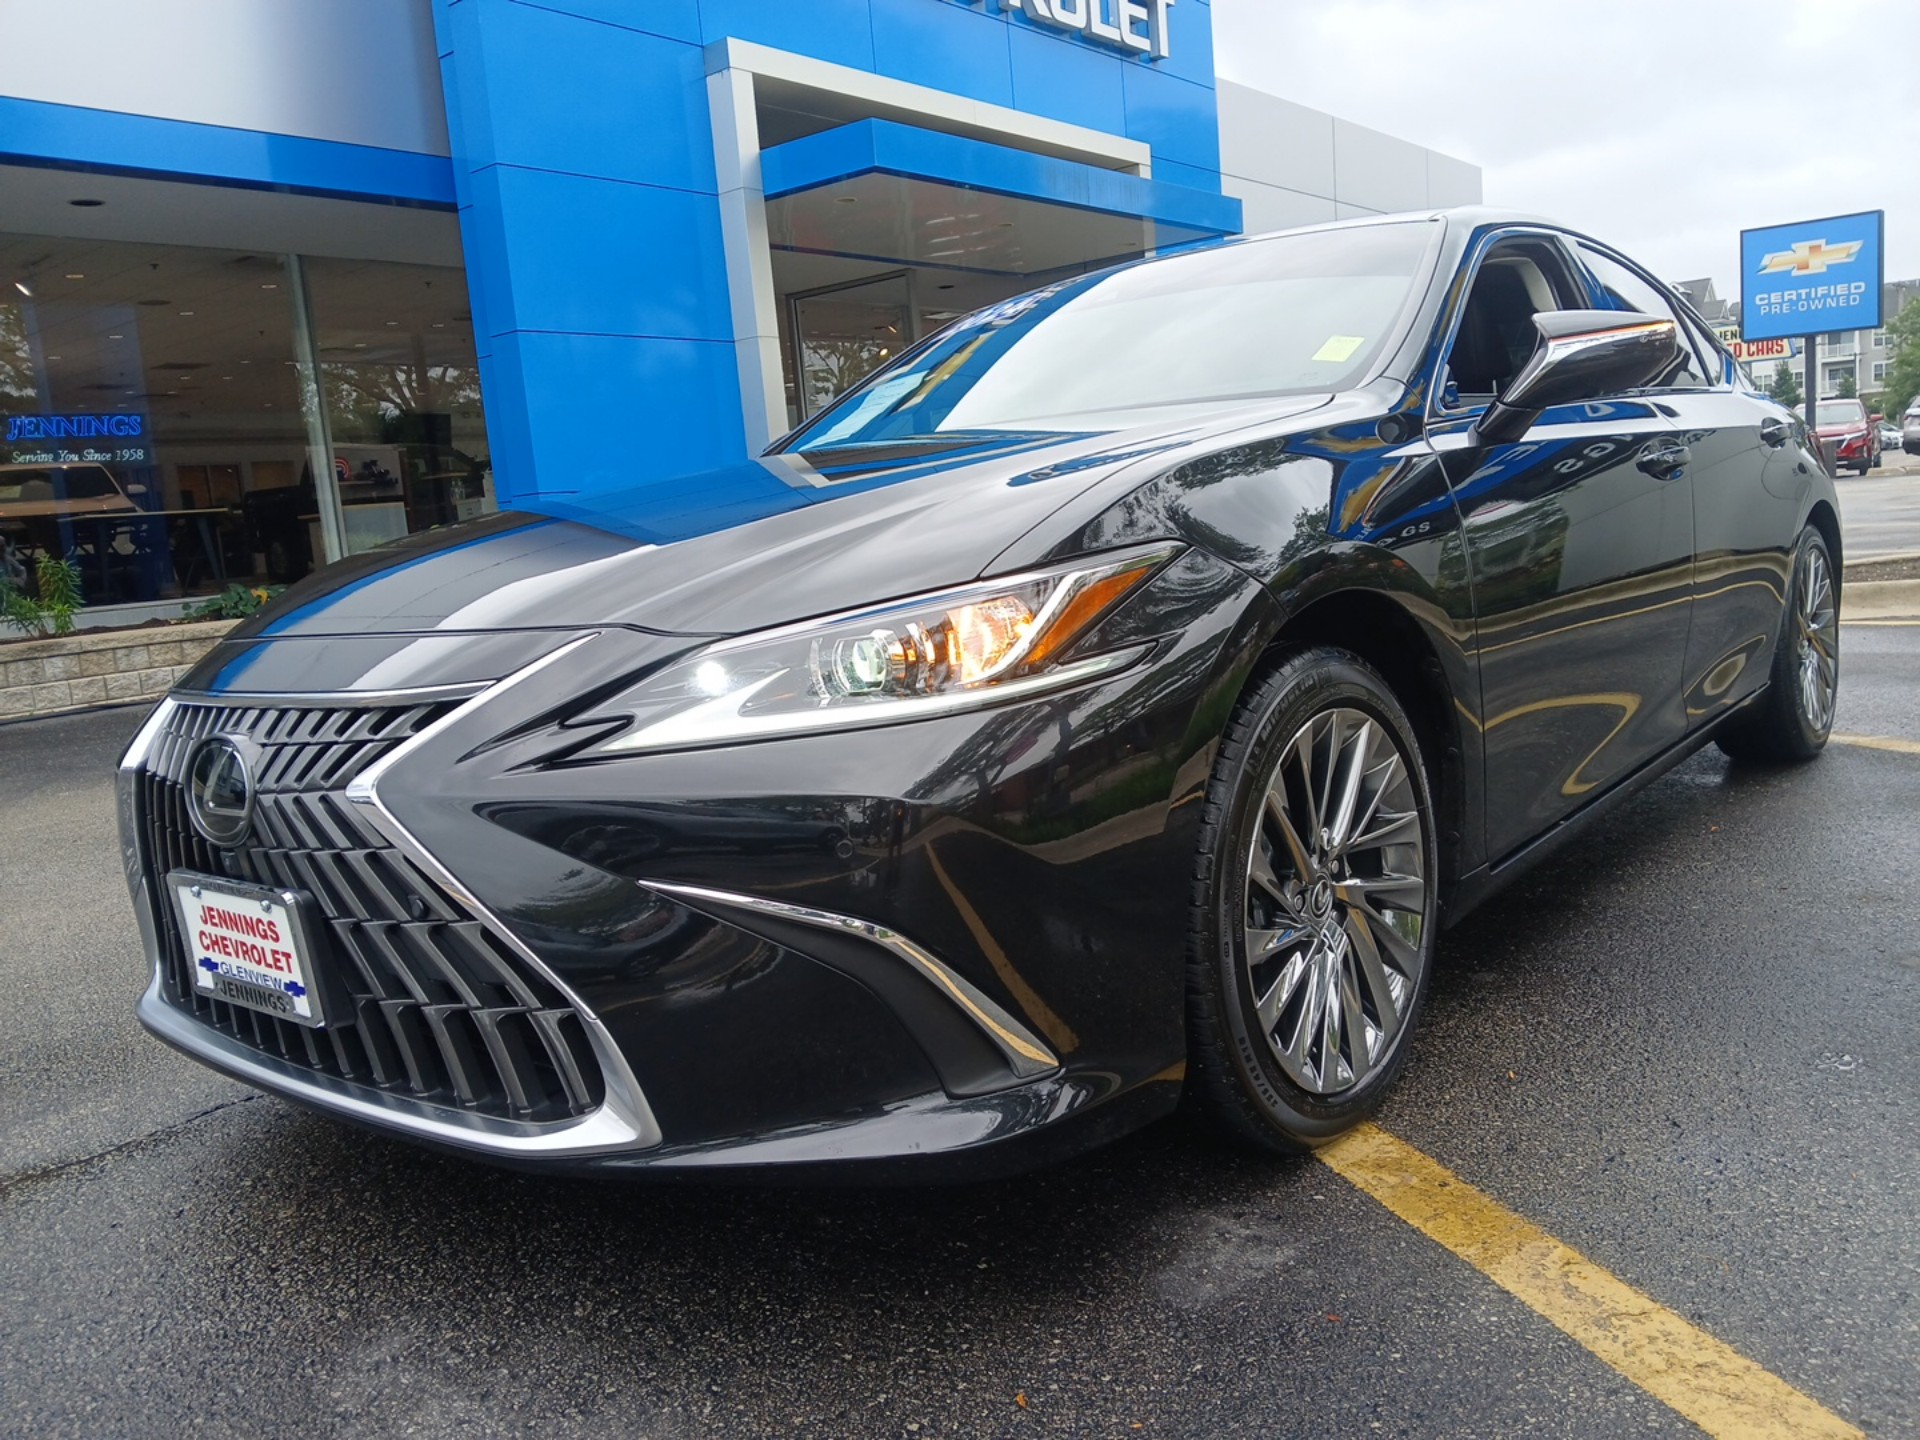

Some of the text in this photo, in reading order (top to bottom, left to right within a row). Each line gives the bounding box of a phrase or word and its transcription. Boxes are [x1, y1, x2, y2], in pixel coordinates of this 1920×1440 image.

[1755, 281, 1866, 305] CERTIFIED
[1760, 294, 1860, 316] PRE-OWNED
[1747, 338, 1784, 357] CARS
[6, 415, 142, 441] JENNINGS
[58, 450, 79, 462] You
[83, 448, 112, 461] Since
[116, 448, 145, 461] 1958
[200, 905, 280, 943] JENNINGS
[199, 930, 292, 974] CHEVROLET
[220, 961, 282, 990] GLENVIEW
[220, 980, 286, 1013] JENNINGS
